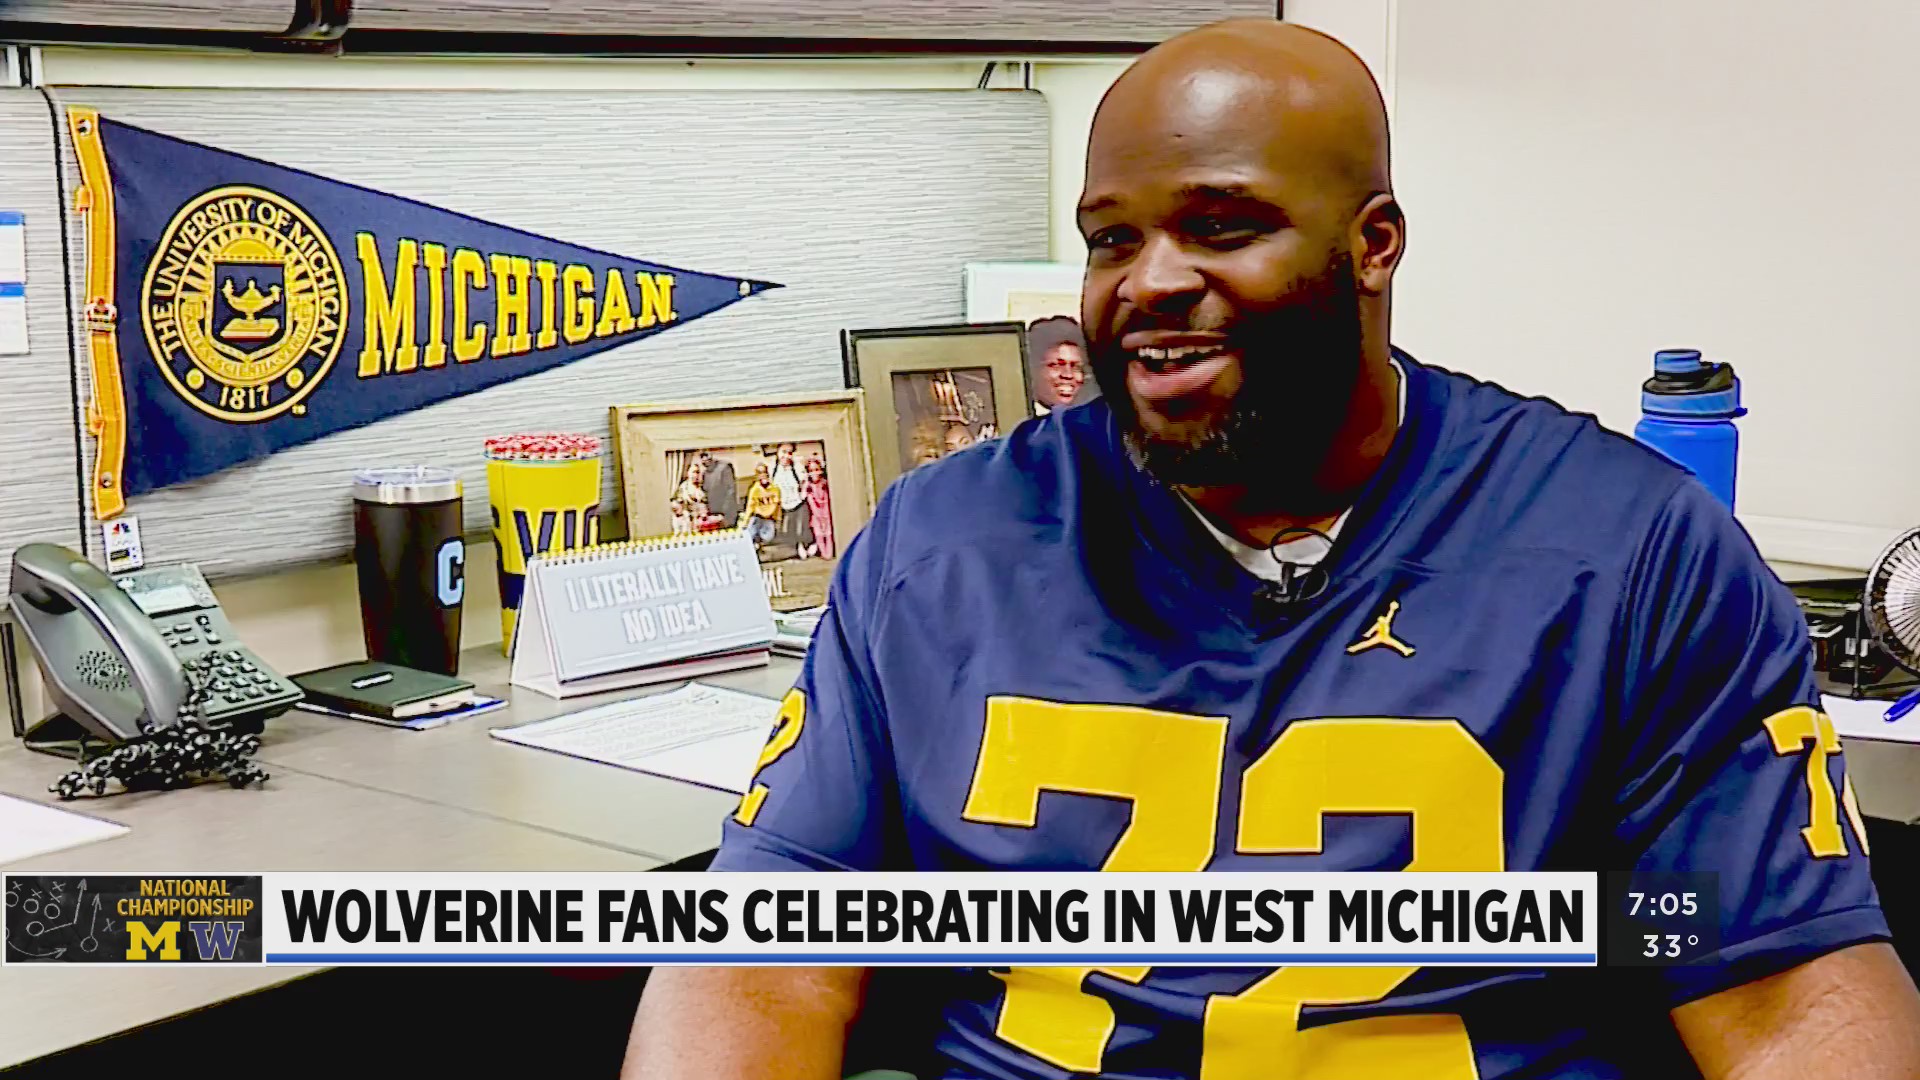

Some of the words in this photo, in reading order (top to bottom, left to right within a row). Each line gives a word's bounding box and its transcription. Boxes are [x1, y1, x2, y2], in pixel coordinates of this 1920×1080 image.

[255, 201, 291, 231] OF
[153, 197, 254, 297] UNIVERSITY
[287, 221, 341, 358] MICHIGAN
[152, 301, 183, 361] THE
[219, 384, 271, 411] 1817
[436, 538, 464, 608] C
[565, 577, 580, 613] I
[579, 561, 687, 611] LITERALLY
[686, 553, 745, 592] HAVE
[621, 606, 657, 644] NO
[658, 599, 712, 638] IDEA
